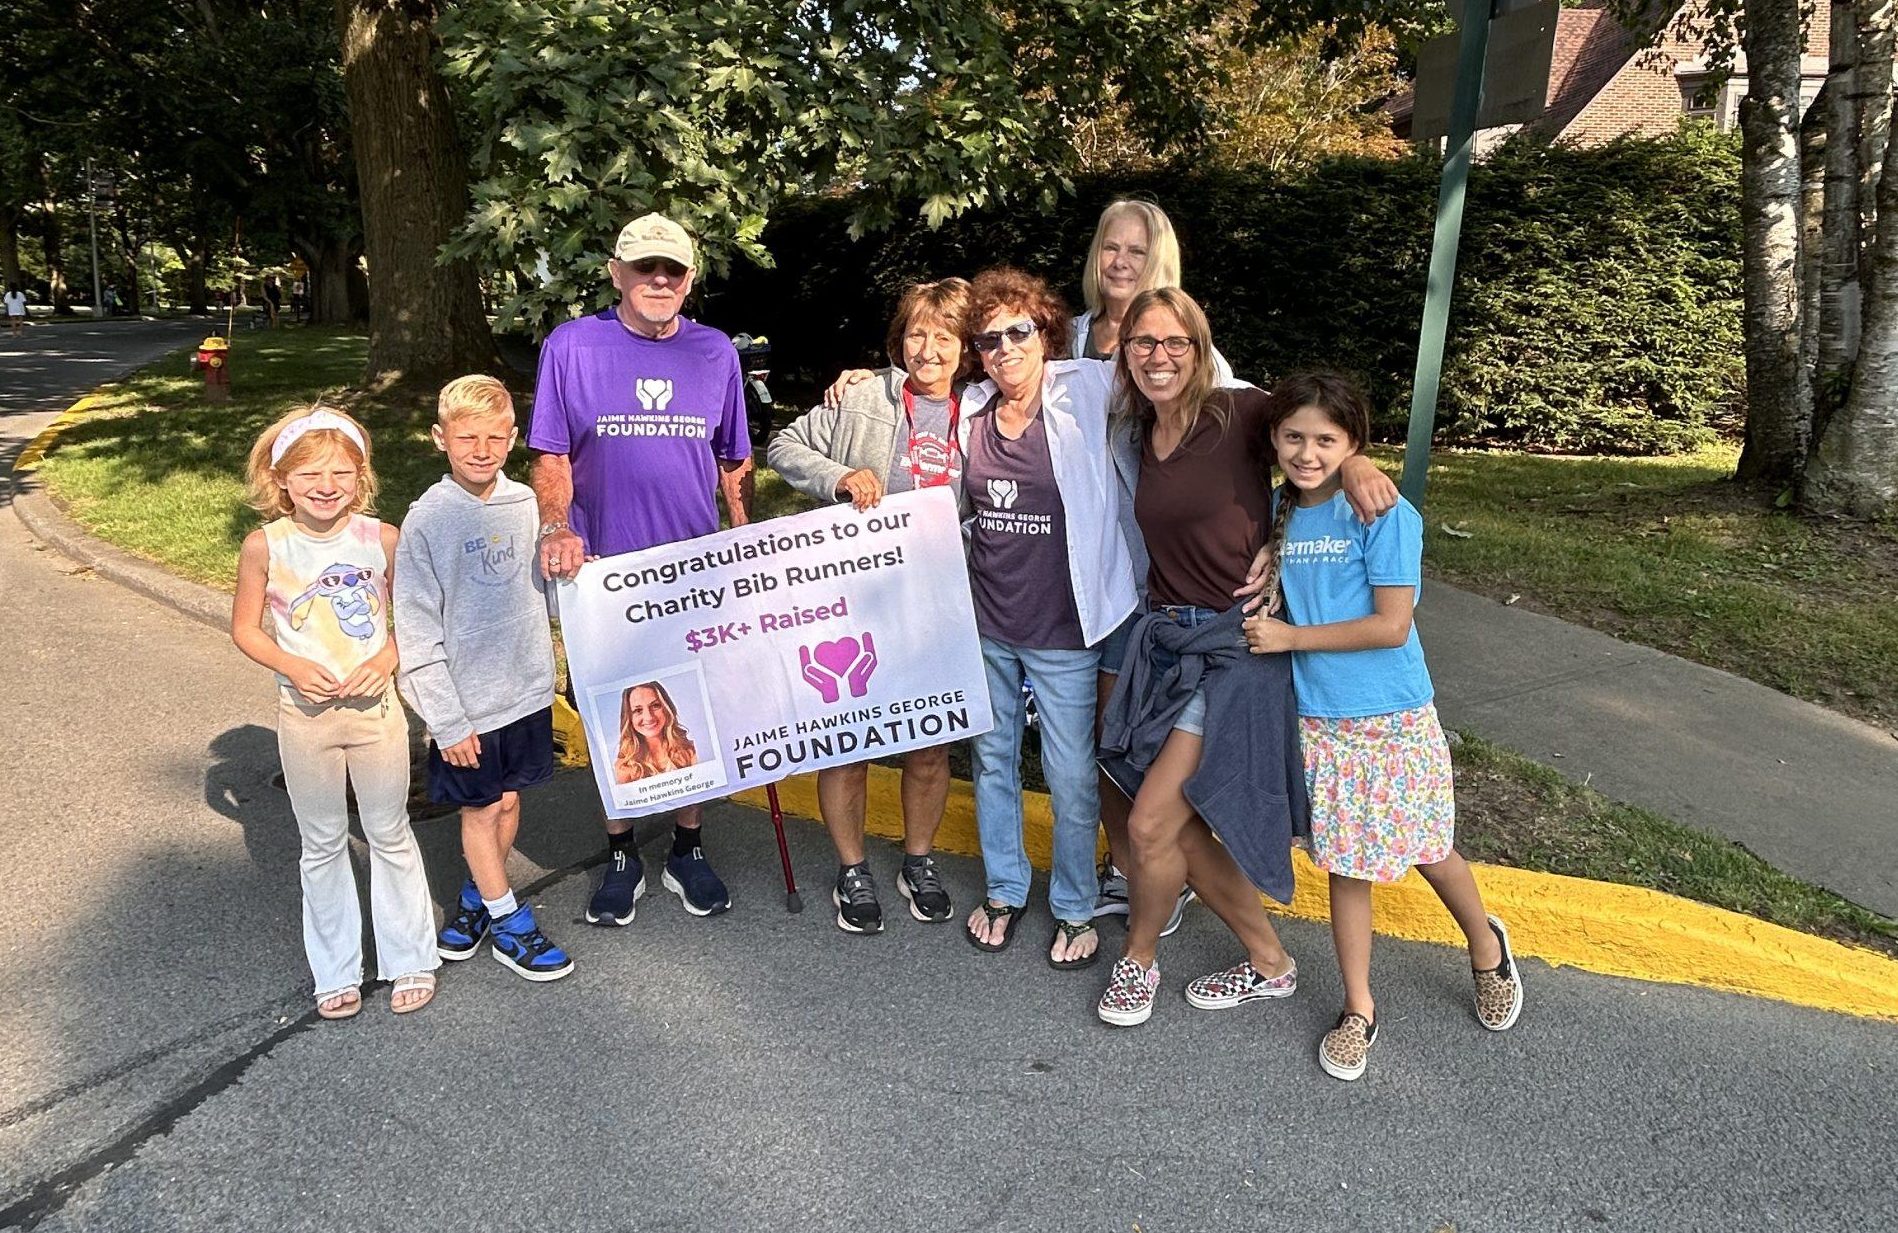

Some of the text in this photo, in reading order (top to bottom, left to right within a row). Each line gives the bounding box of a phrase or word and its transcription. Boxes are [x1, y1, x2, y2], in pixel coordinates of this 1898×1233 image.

[596, 415, 706, 425] JAIME HAWKINS GEORGE
[596, 423, 707, 439] FOUNDATION
[978, 517, 1051, 535] UNDATION
[982, 510, 1016, 520] HAWKINS
[1017, 513, 1052, 523] GEORGE
[464, 537, 487, 554] BE
[602, 512, 911, 593] Congratulations to our
[625, 546, 905, 624] Charity Bib Runners!
[685, 596, 849, 653] $3K+ Raised
[733, 690, 966, 752] JAIME HAWKINS GEORGE
[735, 707, 970, 779] FOUNDATION
[624, 779, 715, 807] Jaime Hawkins George
[638, 772, 693, 794] In memory of
